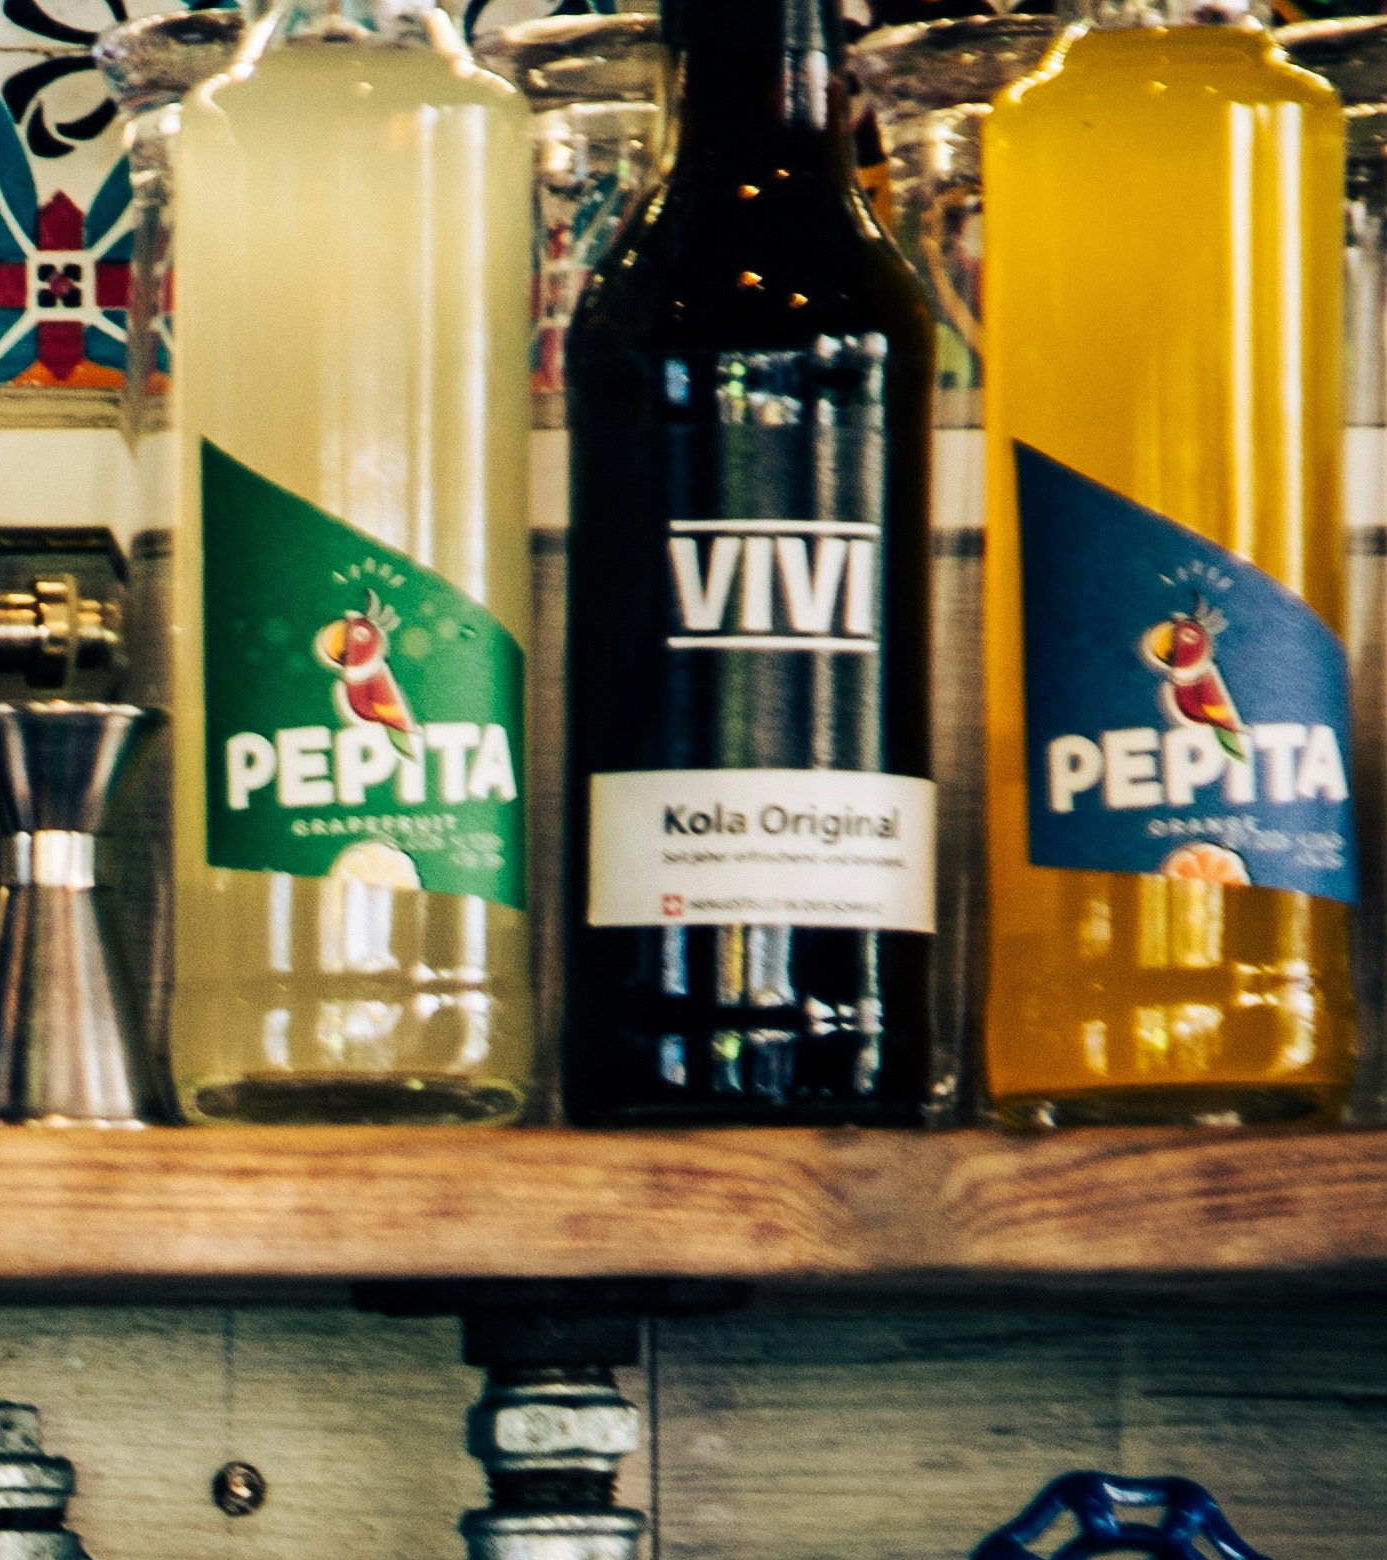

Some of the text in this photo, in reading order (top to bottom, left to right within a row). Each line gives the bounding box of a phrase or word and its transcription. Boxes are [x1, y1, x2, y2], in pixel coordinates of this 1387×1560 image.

[668, 534, 876, 632] VIVI
[226, 721, 517, 811] PEPITA
[1047, 723, 1350, 814] PEPITA
[663, 802, 899, 844] Kola Original
